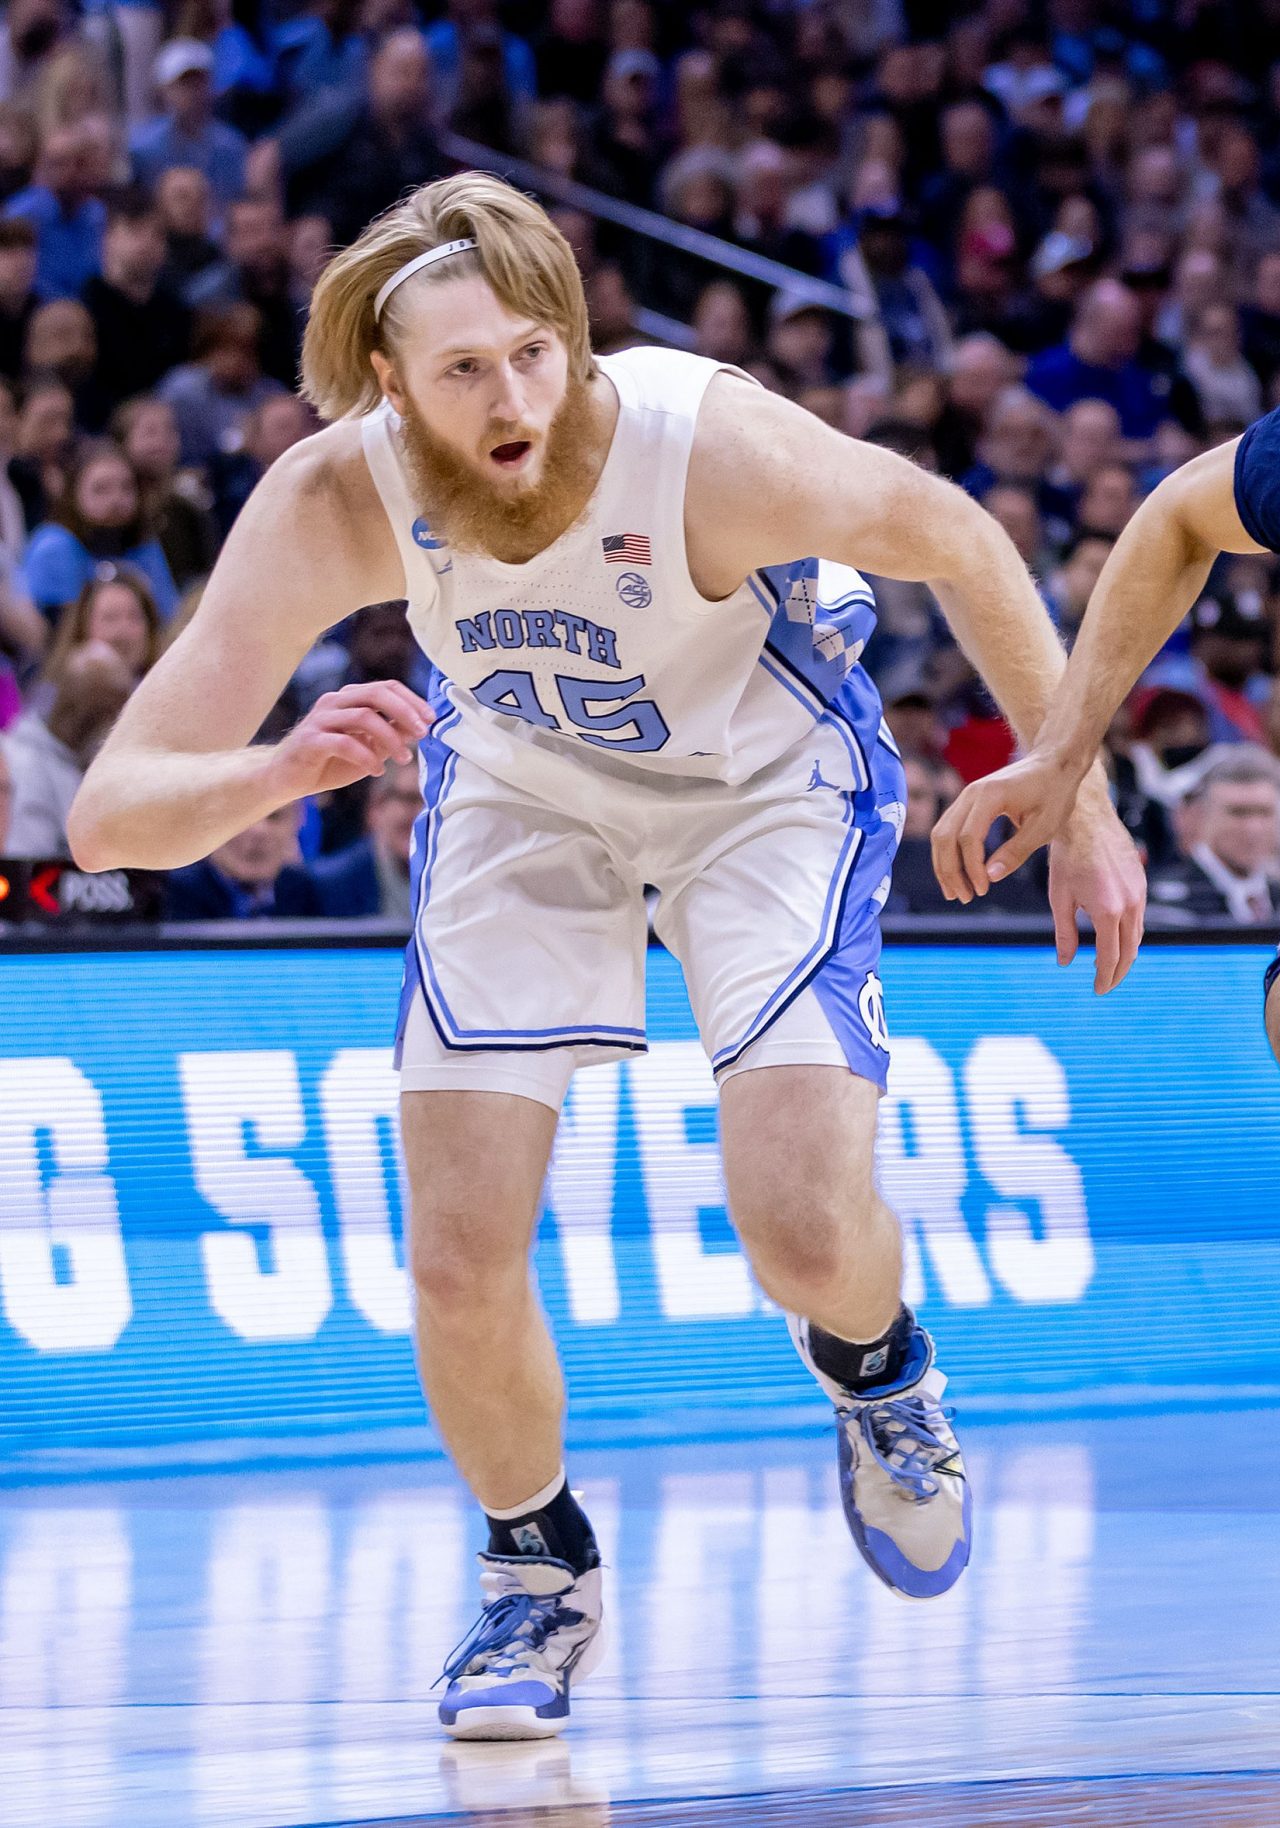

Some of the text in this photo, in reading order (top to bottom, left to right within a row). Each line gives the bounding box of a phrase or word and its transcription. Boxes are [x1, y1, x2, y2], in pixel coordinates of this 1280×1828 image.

[455, 608, 622, 669] NORTH
[469, 669, 672, 753] 45
[550, 1036, 1097, 1324] YERS
